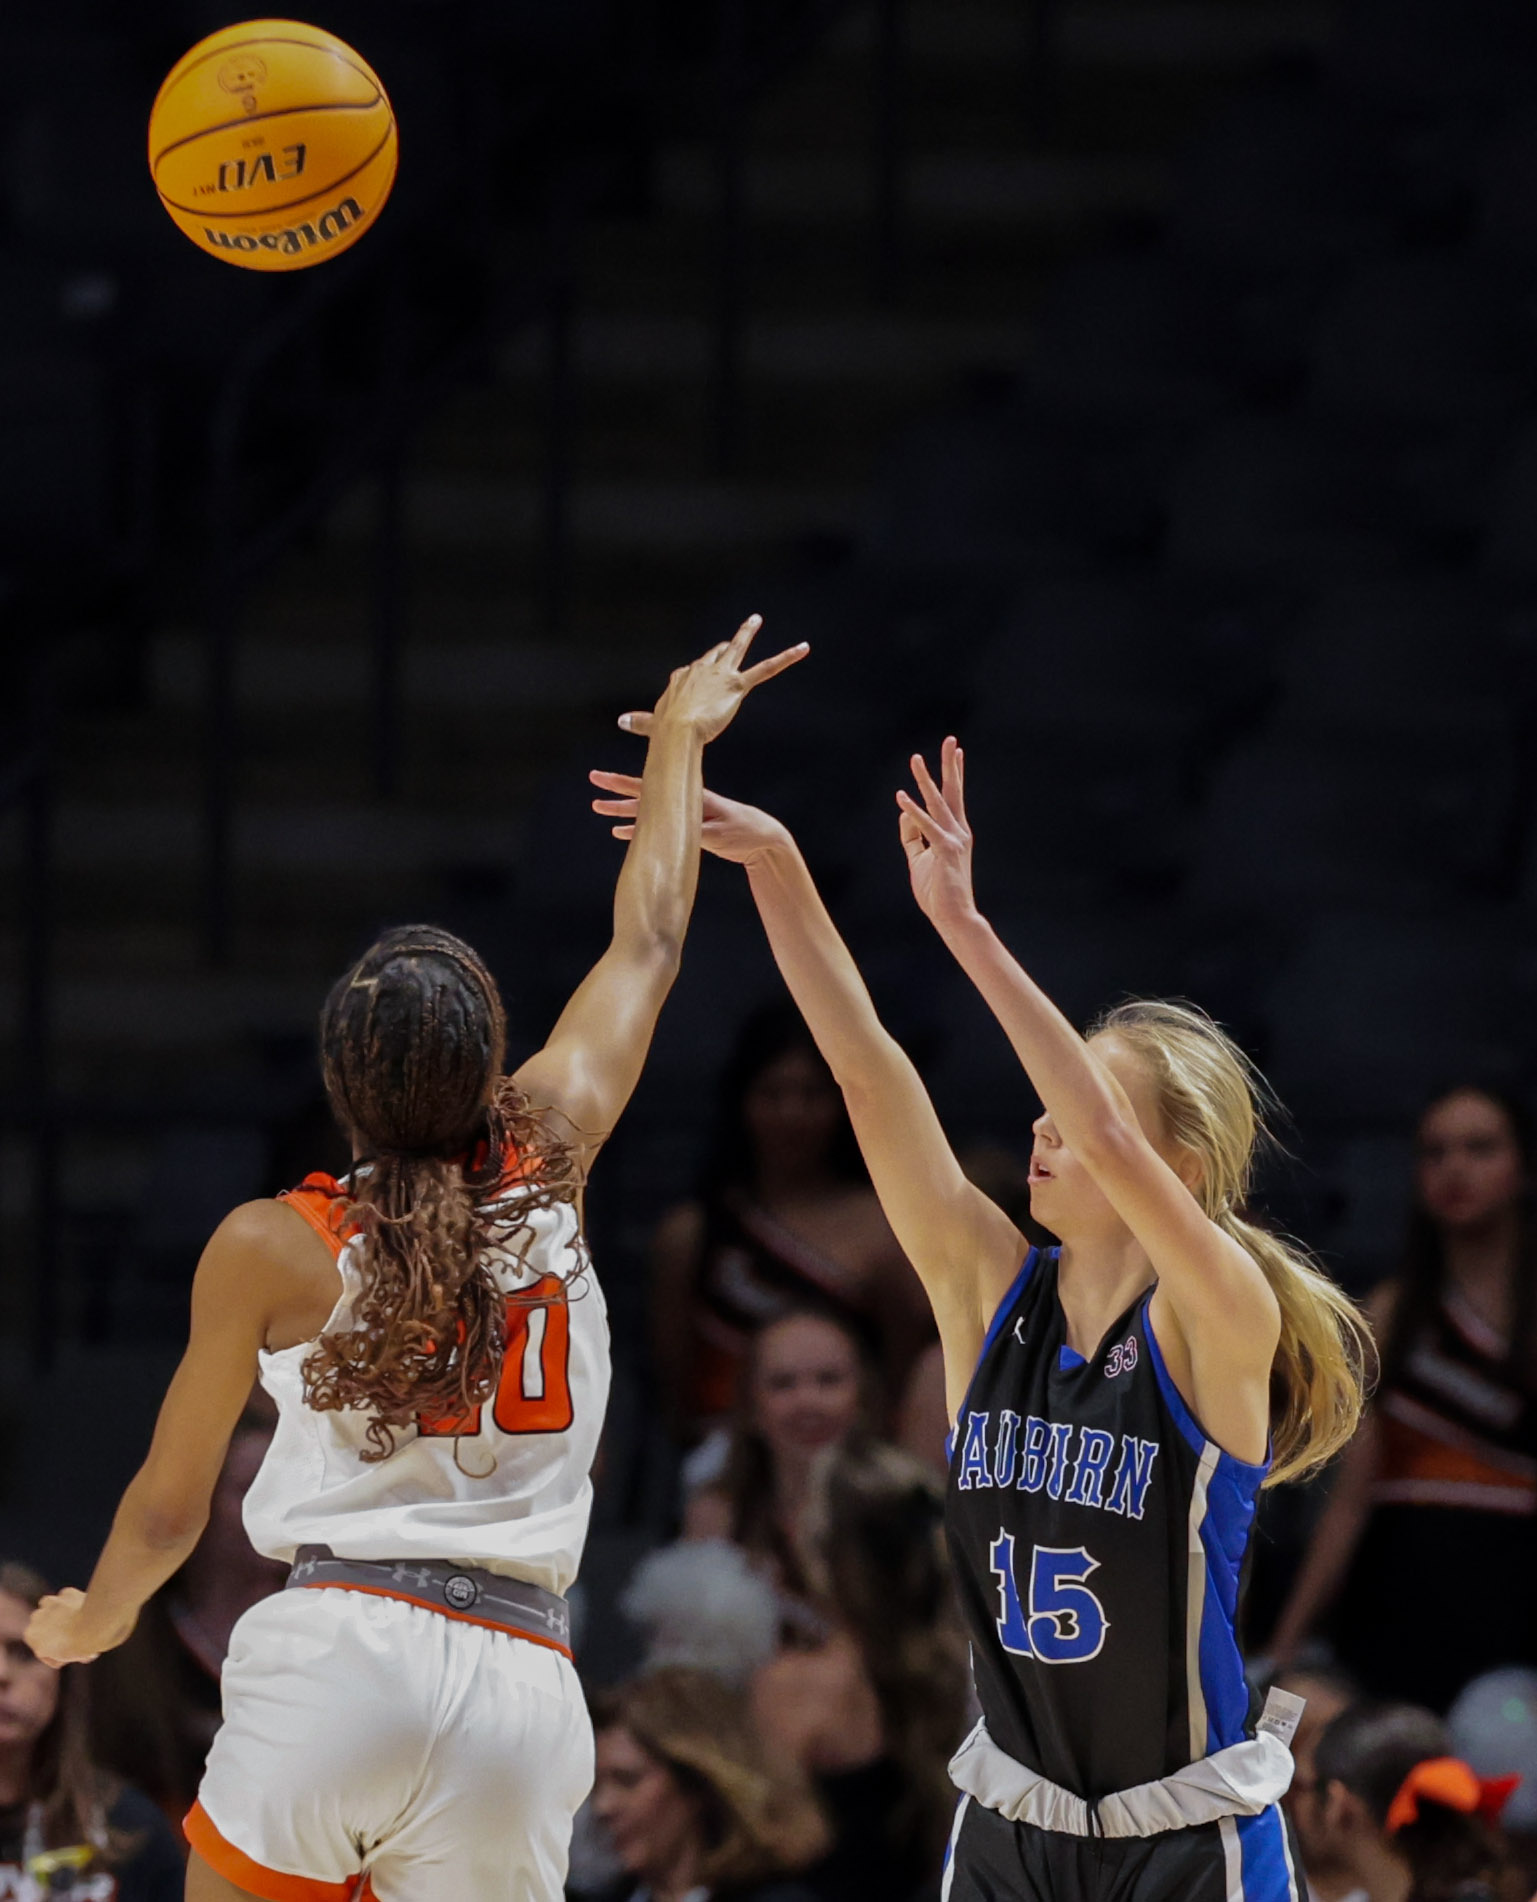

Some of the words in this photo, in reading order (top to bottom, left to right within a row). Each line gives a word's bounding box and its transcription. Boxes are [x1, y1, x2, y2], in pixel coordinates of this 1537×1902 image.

[216, 143, 308, 193] EVO
[203, 195, 365, 255] Wilson
[1104, 1335, 1139, 1379] 33
[958, 1409, 1160, 1521] AUBURN
[989, 1526, 1112, 1665] 15
